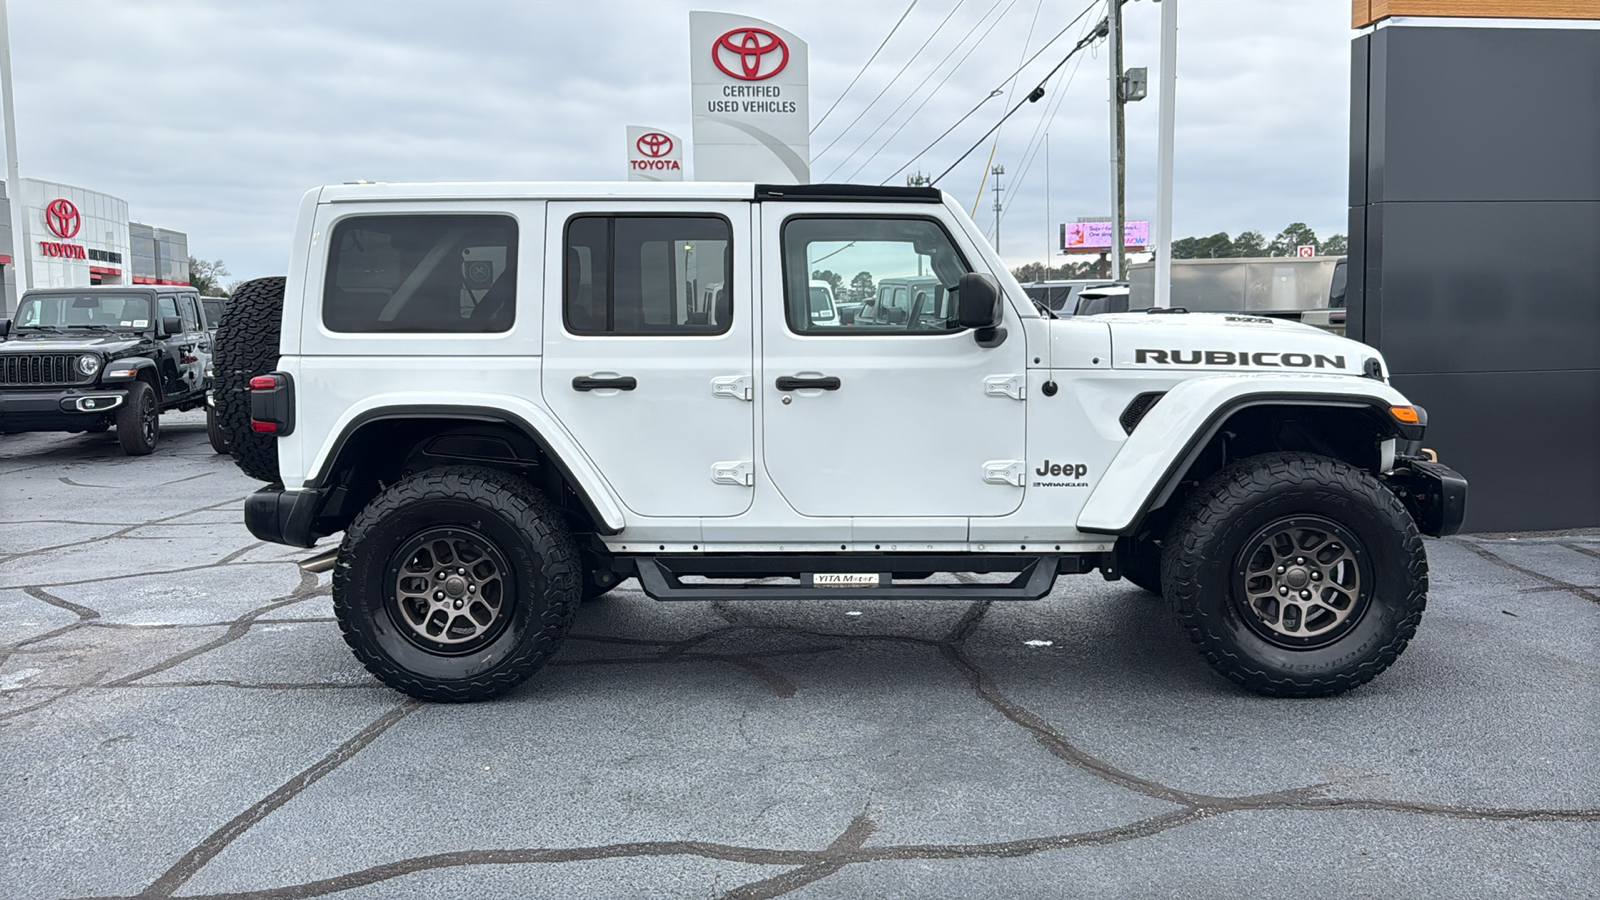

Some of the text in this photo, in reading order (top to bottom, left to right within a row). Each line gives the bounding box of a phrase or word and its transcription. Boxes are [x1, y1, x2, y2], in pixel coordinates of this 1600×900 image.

[723, 86, 780, 98] CERTIFIED
[708, 101, 796, 113] USED VEHICLES
[630, 159, 681, 171] TOYOTA
[41, 242, 86, 260] TOYOTA
[1135, 348, 1346, 369] RUBICON
[1036, 460, 1087, 479] Jeep
[818, 574, 841, 583] YITA
